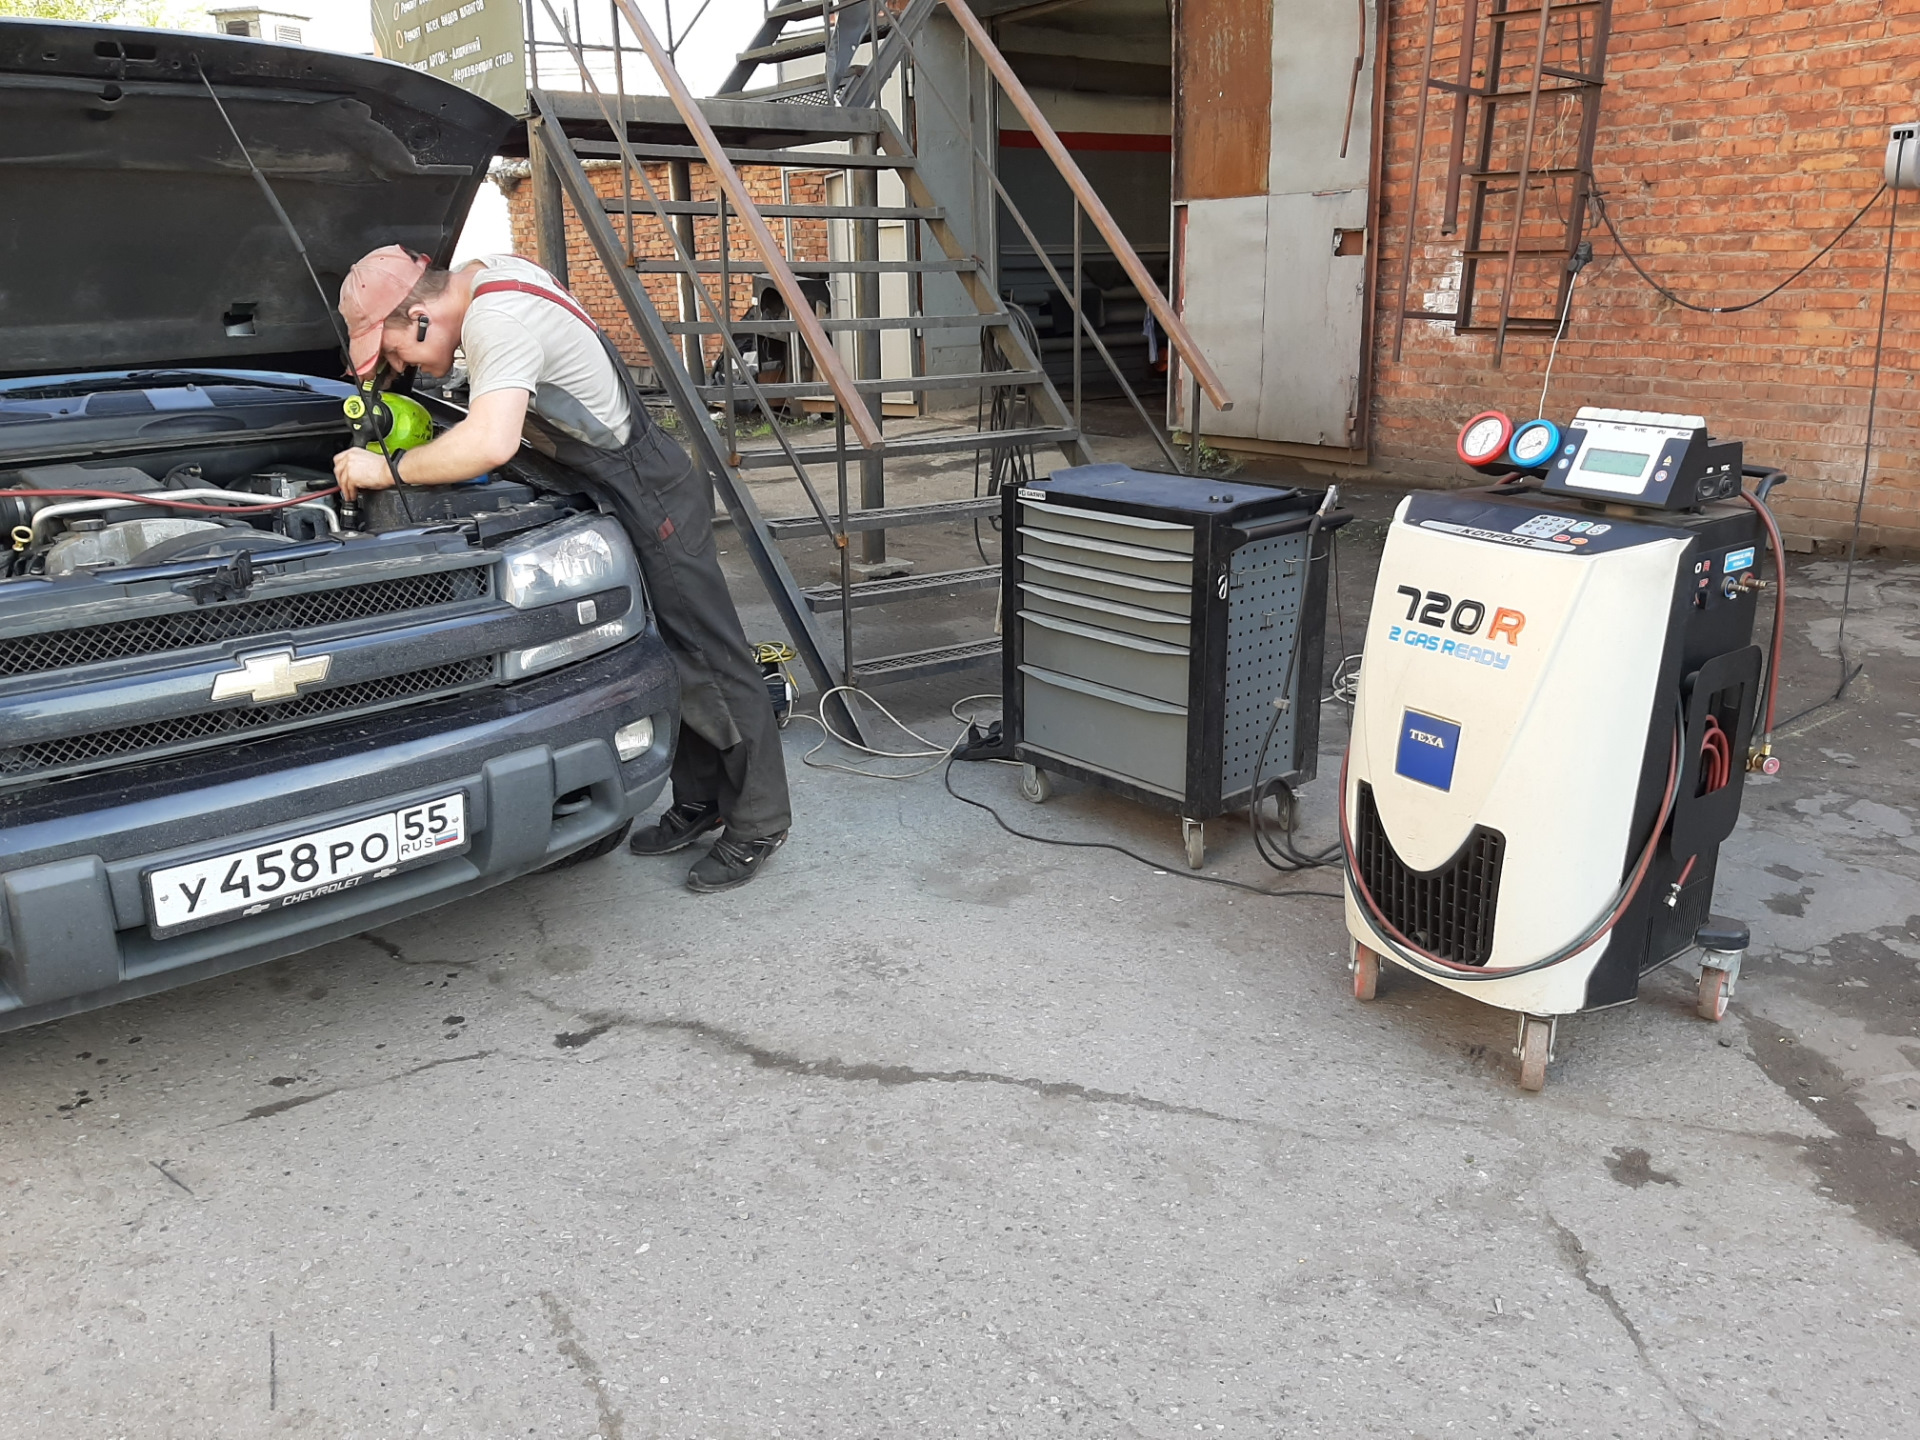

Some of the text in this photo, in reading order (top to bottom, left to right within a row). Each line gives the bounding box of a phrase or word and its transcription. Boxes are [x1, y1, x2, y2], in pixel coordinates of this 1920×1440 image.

[495, 51, 514, 68] сталь
[1388, 625, 1511, 670] 2 GAS READY
[1409, 728, 1445, 749] TEXA
[401, 837, 434, 855] RUS
[282, 876, 363, 906] CHEVROLET
